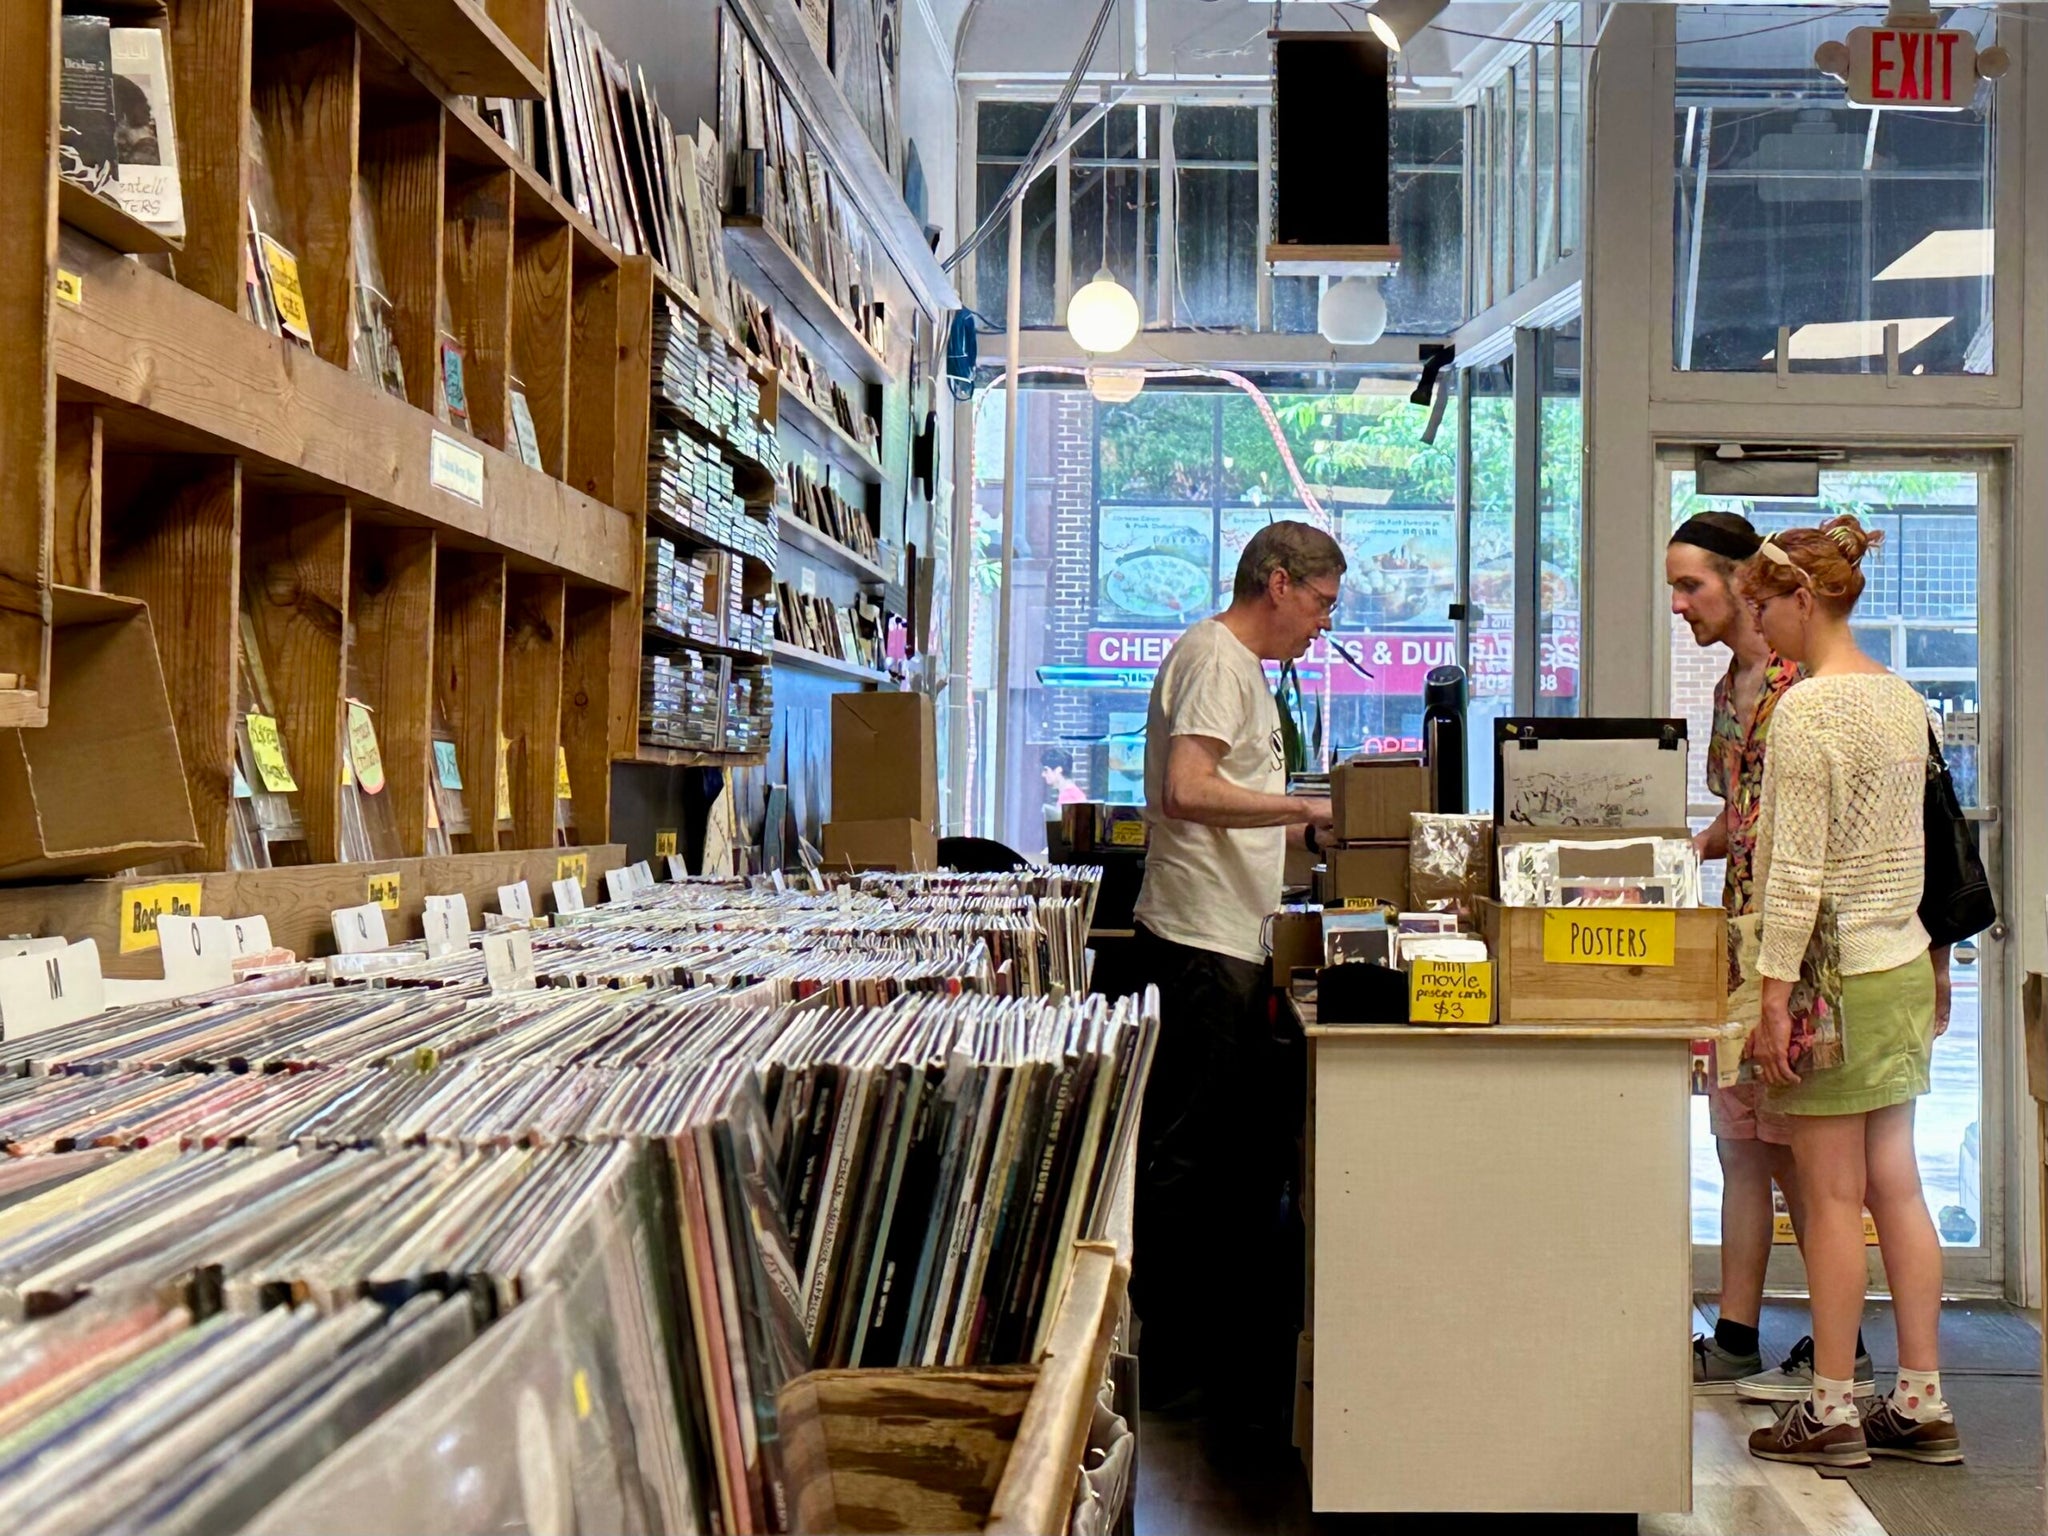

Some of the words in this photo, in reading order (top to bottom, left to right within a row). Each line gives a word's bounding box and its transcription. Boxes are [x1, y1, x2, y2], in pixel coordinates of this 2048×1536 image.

[98, 61, 105, 71] 2
[1872, 31, 1959, 100] EXIT
[1372, 641, 1393, 665] &
[1365, 737, 1424, 754] OPE
[1571, 922, 1647, 958] POSTERS
[1421, 973, 1480, 989] movie
